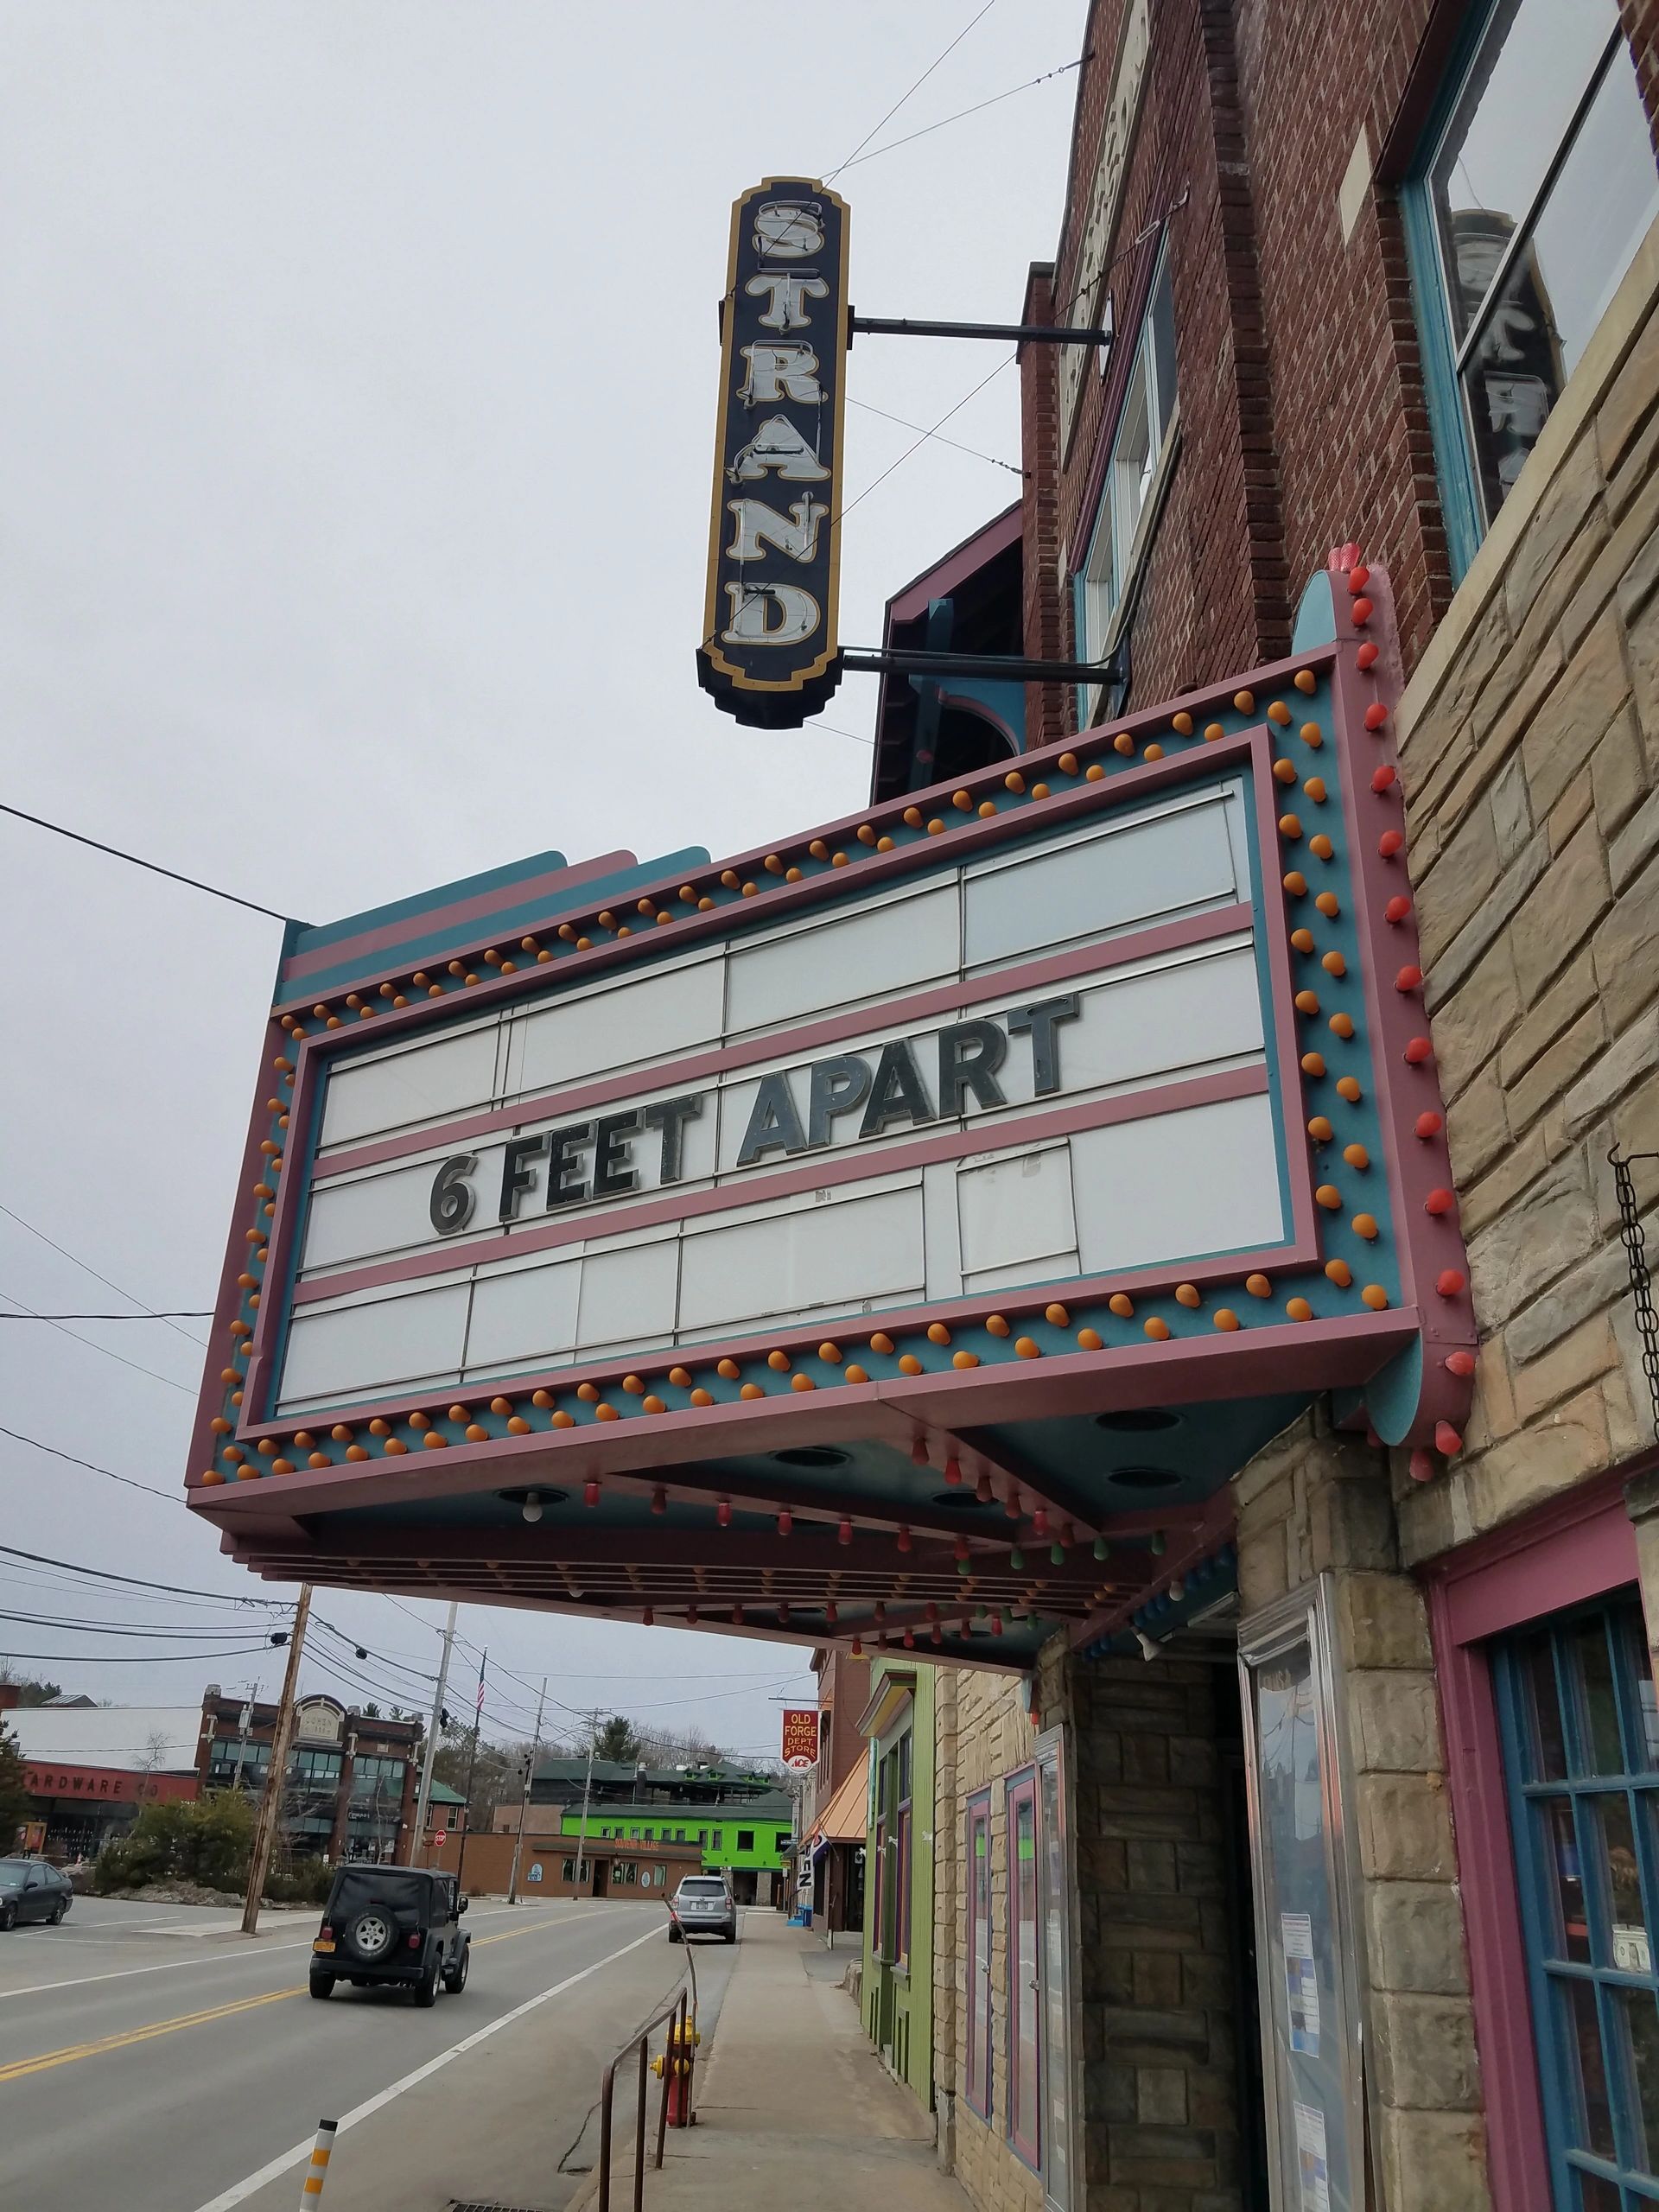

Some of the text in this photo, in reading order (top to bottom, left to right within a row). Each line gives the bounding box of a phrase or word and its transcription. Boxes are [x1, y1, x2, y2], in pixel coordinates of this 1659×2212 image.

[721, 200, 831, 645] STRAND
[429, 992, 1081, 1235] 6 FEET APART
[791, 1713, 810, 1724] OLD
[785, 1726, 817, 1737] FORGE
[787, 1738, 814, 1746] DEPT.
[784, 1745, 817, 1759] STORE
[791, 1758, 810, 1768] ACE
